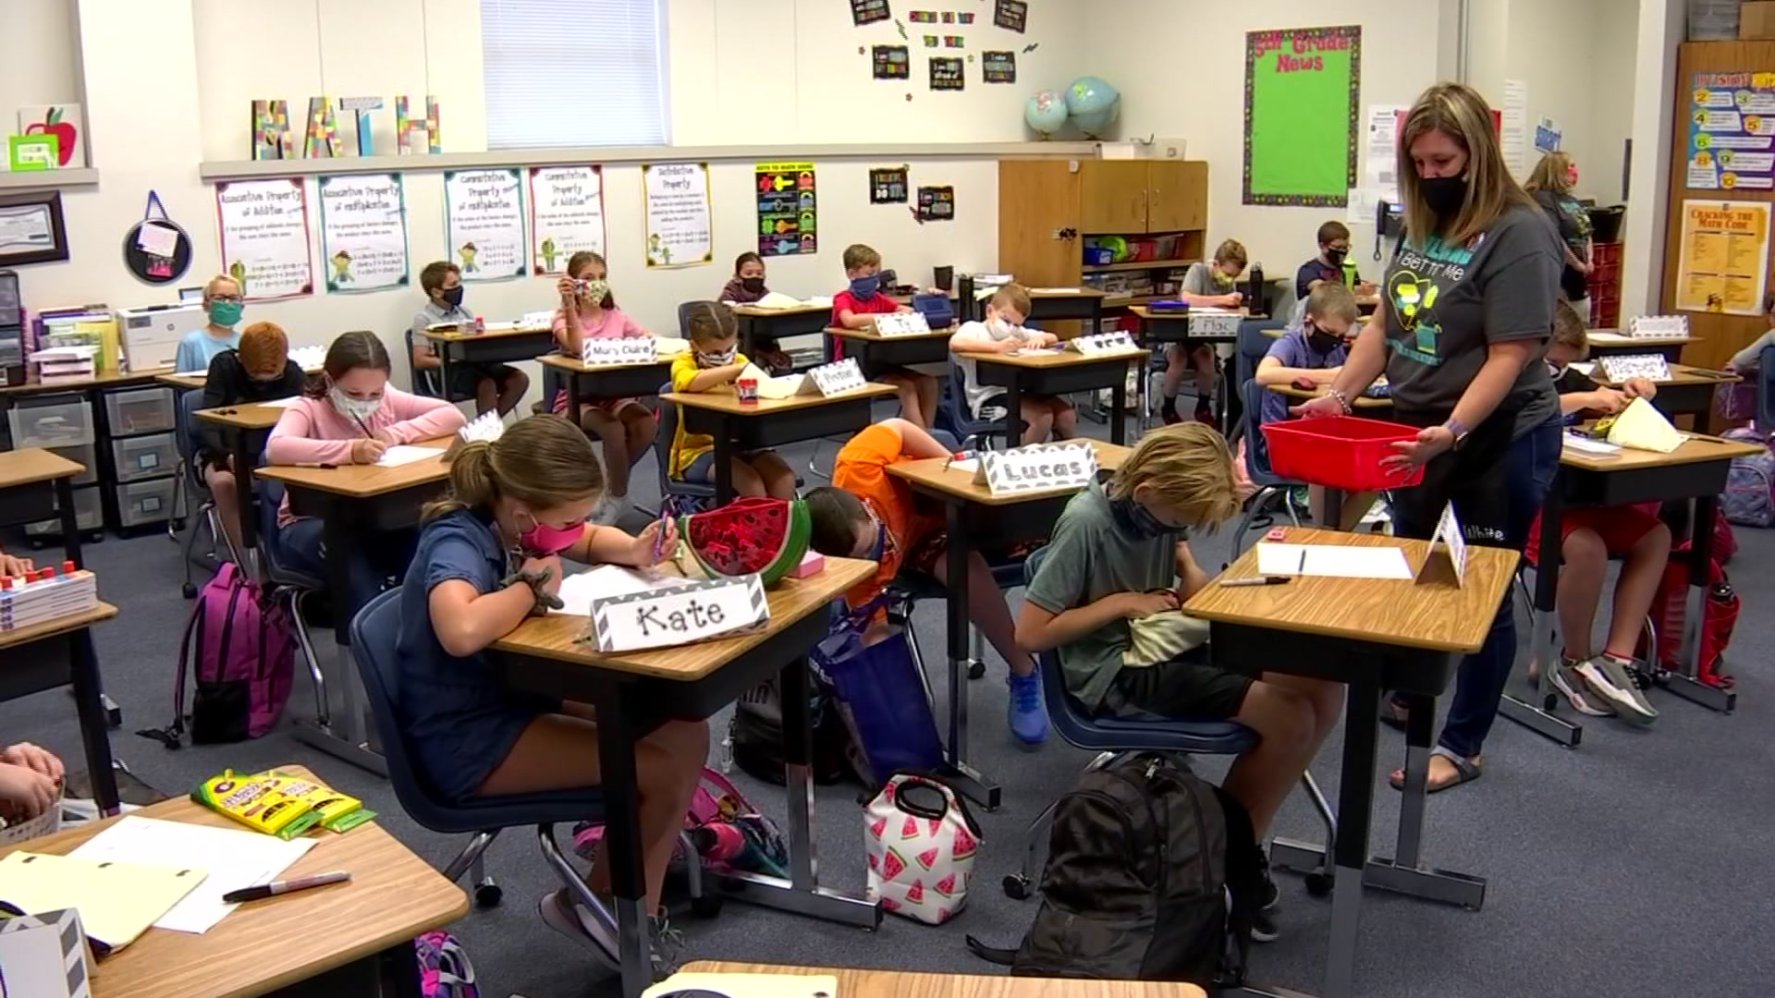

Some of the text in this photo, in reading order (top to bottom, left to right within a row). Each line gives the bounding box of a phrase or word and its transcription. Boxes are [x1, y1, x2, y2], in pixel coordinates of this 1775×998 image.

[1293, 30, 1349, 54] Grade
[1276, 54, 1324, 73] News
[251, 95, 442, 161] MATH
[1003, 461, 1082, 481] Lucas
[637, 600, 726, 636] Kate
